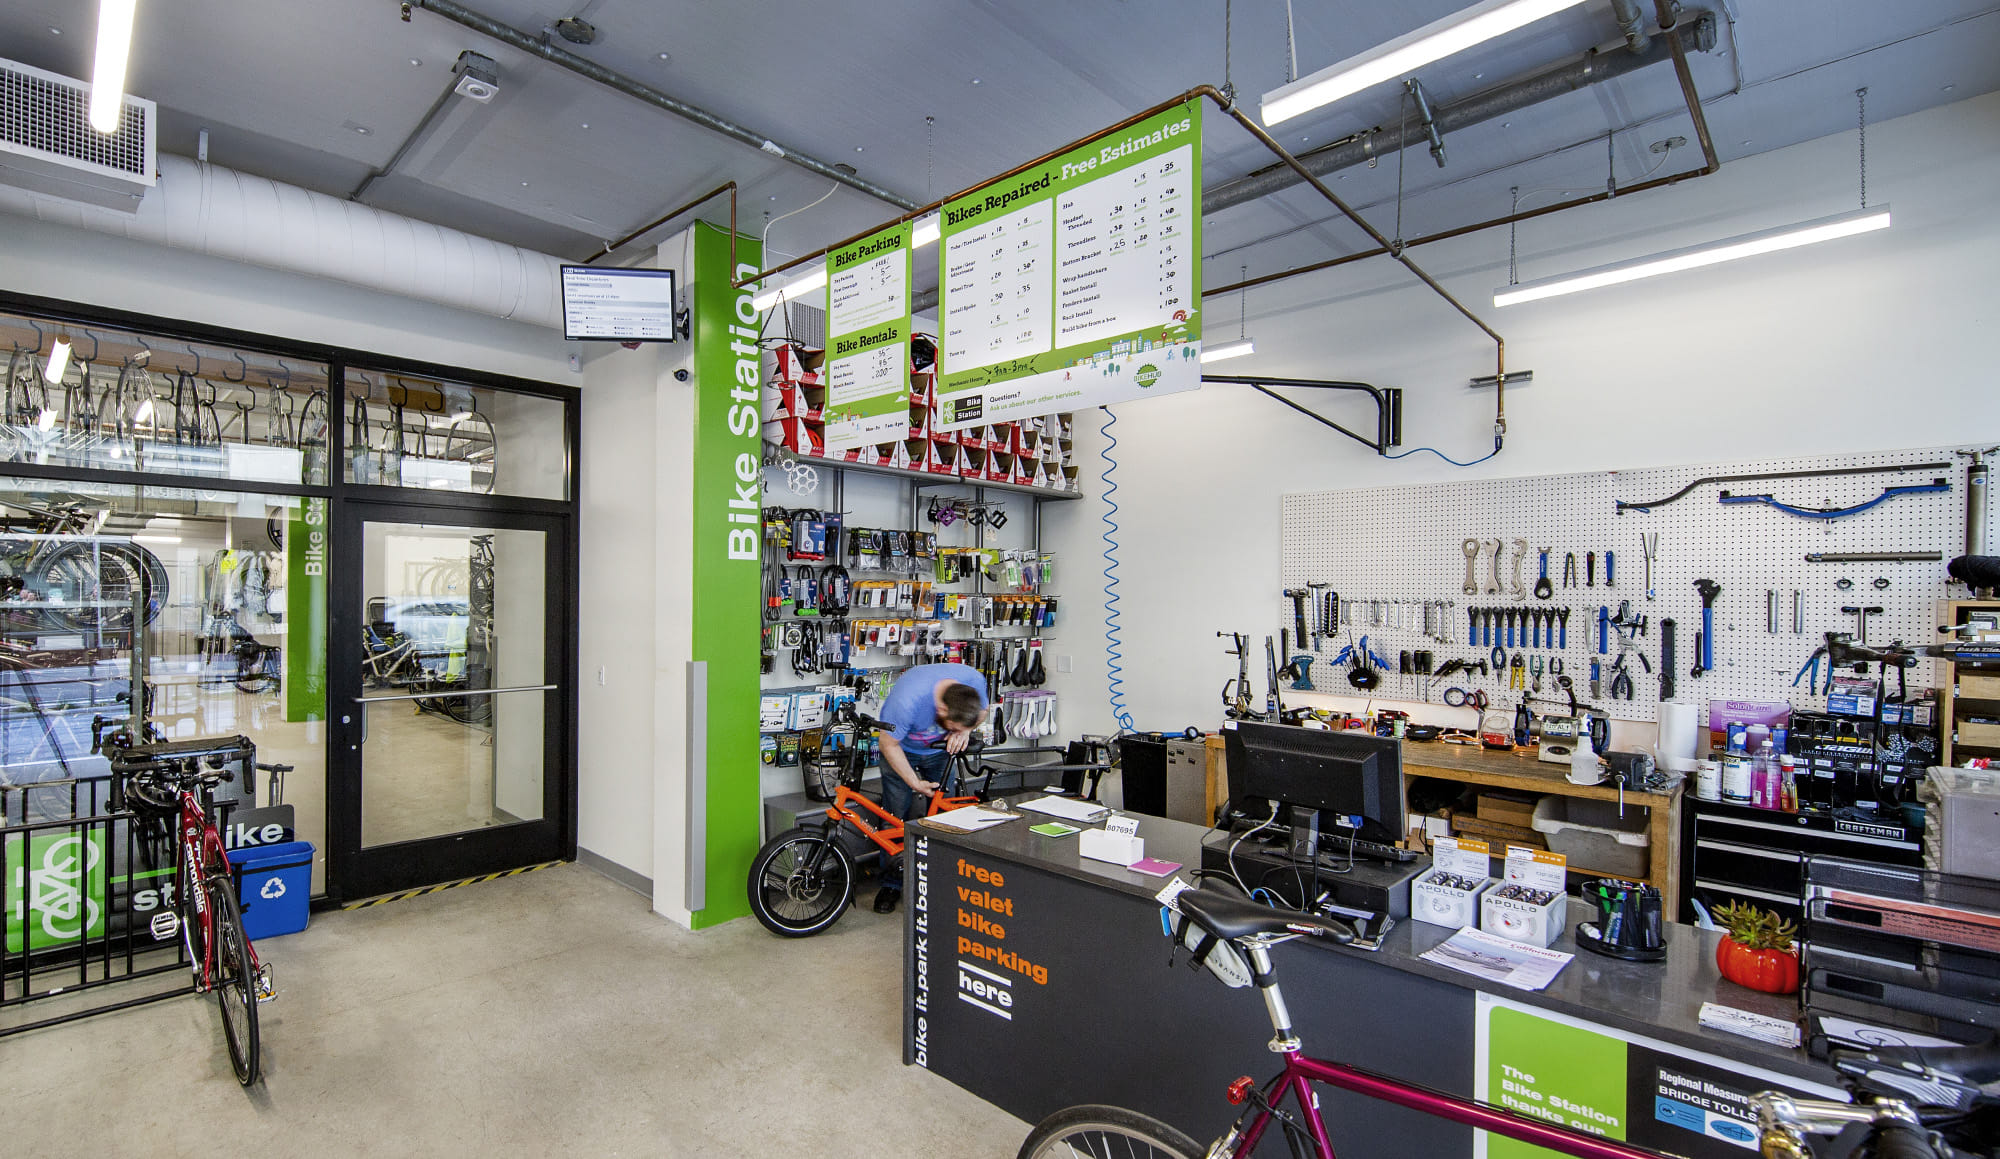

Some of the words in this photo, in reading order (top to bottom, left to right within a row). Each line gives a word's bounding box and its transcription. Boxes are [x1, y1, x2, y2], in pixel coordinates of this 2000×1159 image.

[947, 204, 982, 226] Bikes
[985, 172, 1050, 212] Repaired
[1061, 156, 1097, 180] Free
[1100, 118, 1190, 165] Estimates
[1068, 218, 1092, 231] Threaded
[835, 250, 856, 267] Bike
[859, 235, 900, 258] Parking
[1068, 236, 1096, 249] Threadless
[1114, 238, 1126, 249] 25
[1062, 258, 1080, 267] Bottom
[1082, 250, 1101, 260] Bracket
[1080, 282, 1097, 291] Install
[1083, 294, 1100, 302] Install
[1076, 309, 1092, 318] Install
[1166, 298, 1178, 306] 100
[728, 262, 760, 438] Station
[837, 340, 858, 354] Bike
[860, 328, 898, 348] Rentals
[1134, 370, 1162, 382] BIKEHUB
[966, 398, 980, 407] Bike
[990, 391, 1020, 403] Questions?
[957, 410, 981, 419] Station
[728, 453, 758, 561] Bike
[305, 532, 323, 576] Bike
[226, 824, 284, 849] ike
[1840, 821, 1900, 838] CRAFTSMAN
[185, 842, 205, 914] cannondale
[957, 858, 1004, 887] free
[957, 886, 1014, 917] valet
[1417, 884, 1465, 898] APOLLO
[1485, 898, 1537, 913] APOLLO
[957, 908, 1006, 940] bike
[958, 936, 1048, 985] parking
[1215, 959, 1248, 984] TRANSIT
[959, 970, 1013, 1007] here
[916, 1016, 928, 1067] bike
[1501, 1064, 1535, 1084] The
[1660, 1070, 1702, 1091] Regional
[1703, 1082, 1748, 1104] Measure
[1501, 1094, 1565, 1124] thanks
[1502, 1079, 1543, 1101] Bike
[1549, 1096, 1618, 1127] Station
[1659, 1085, 1711, 1108] BRIDGE
[1712, 1101, 1758, 1122] TOLLS
